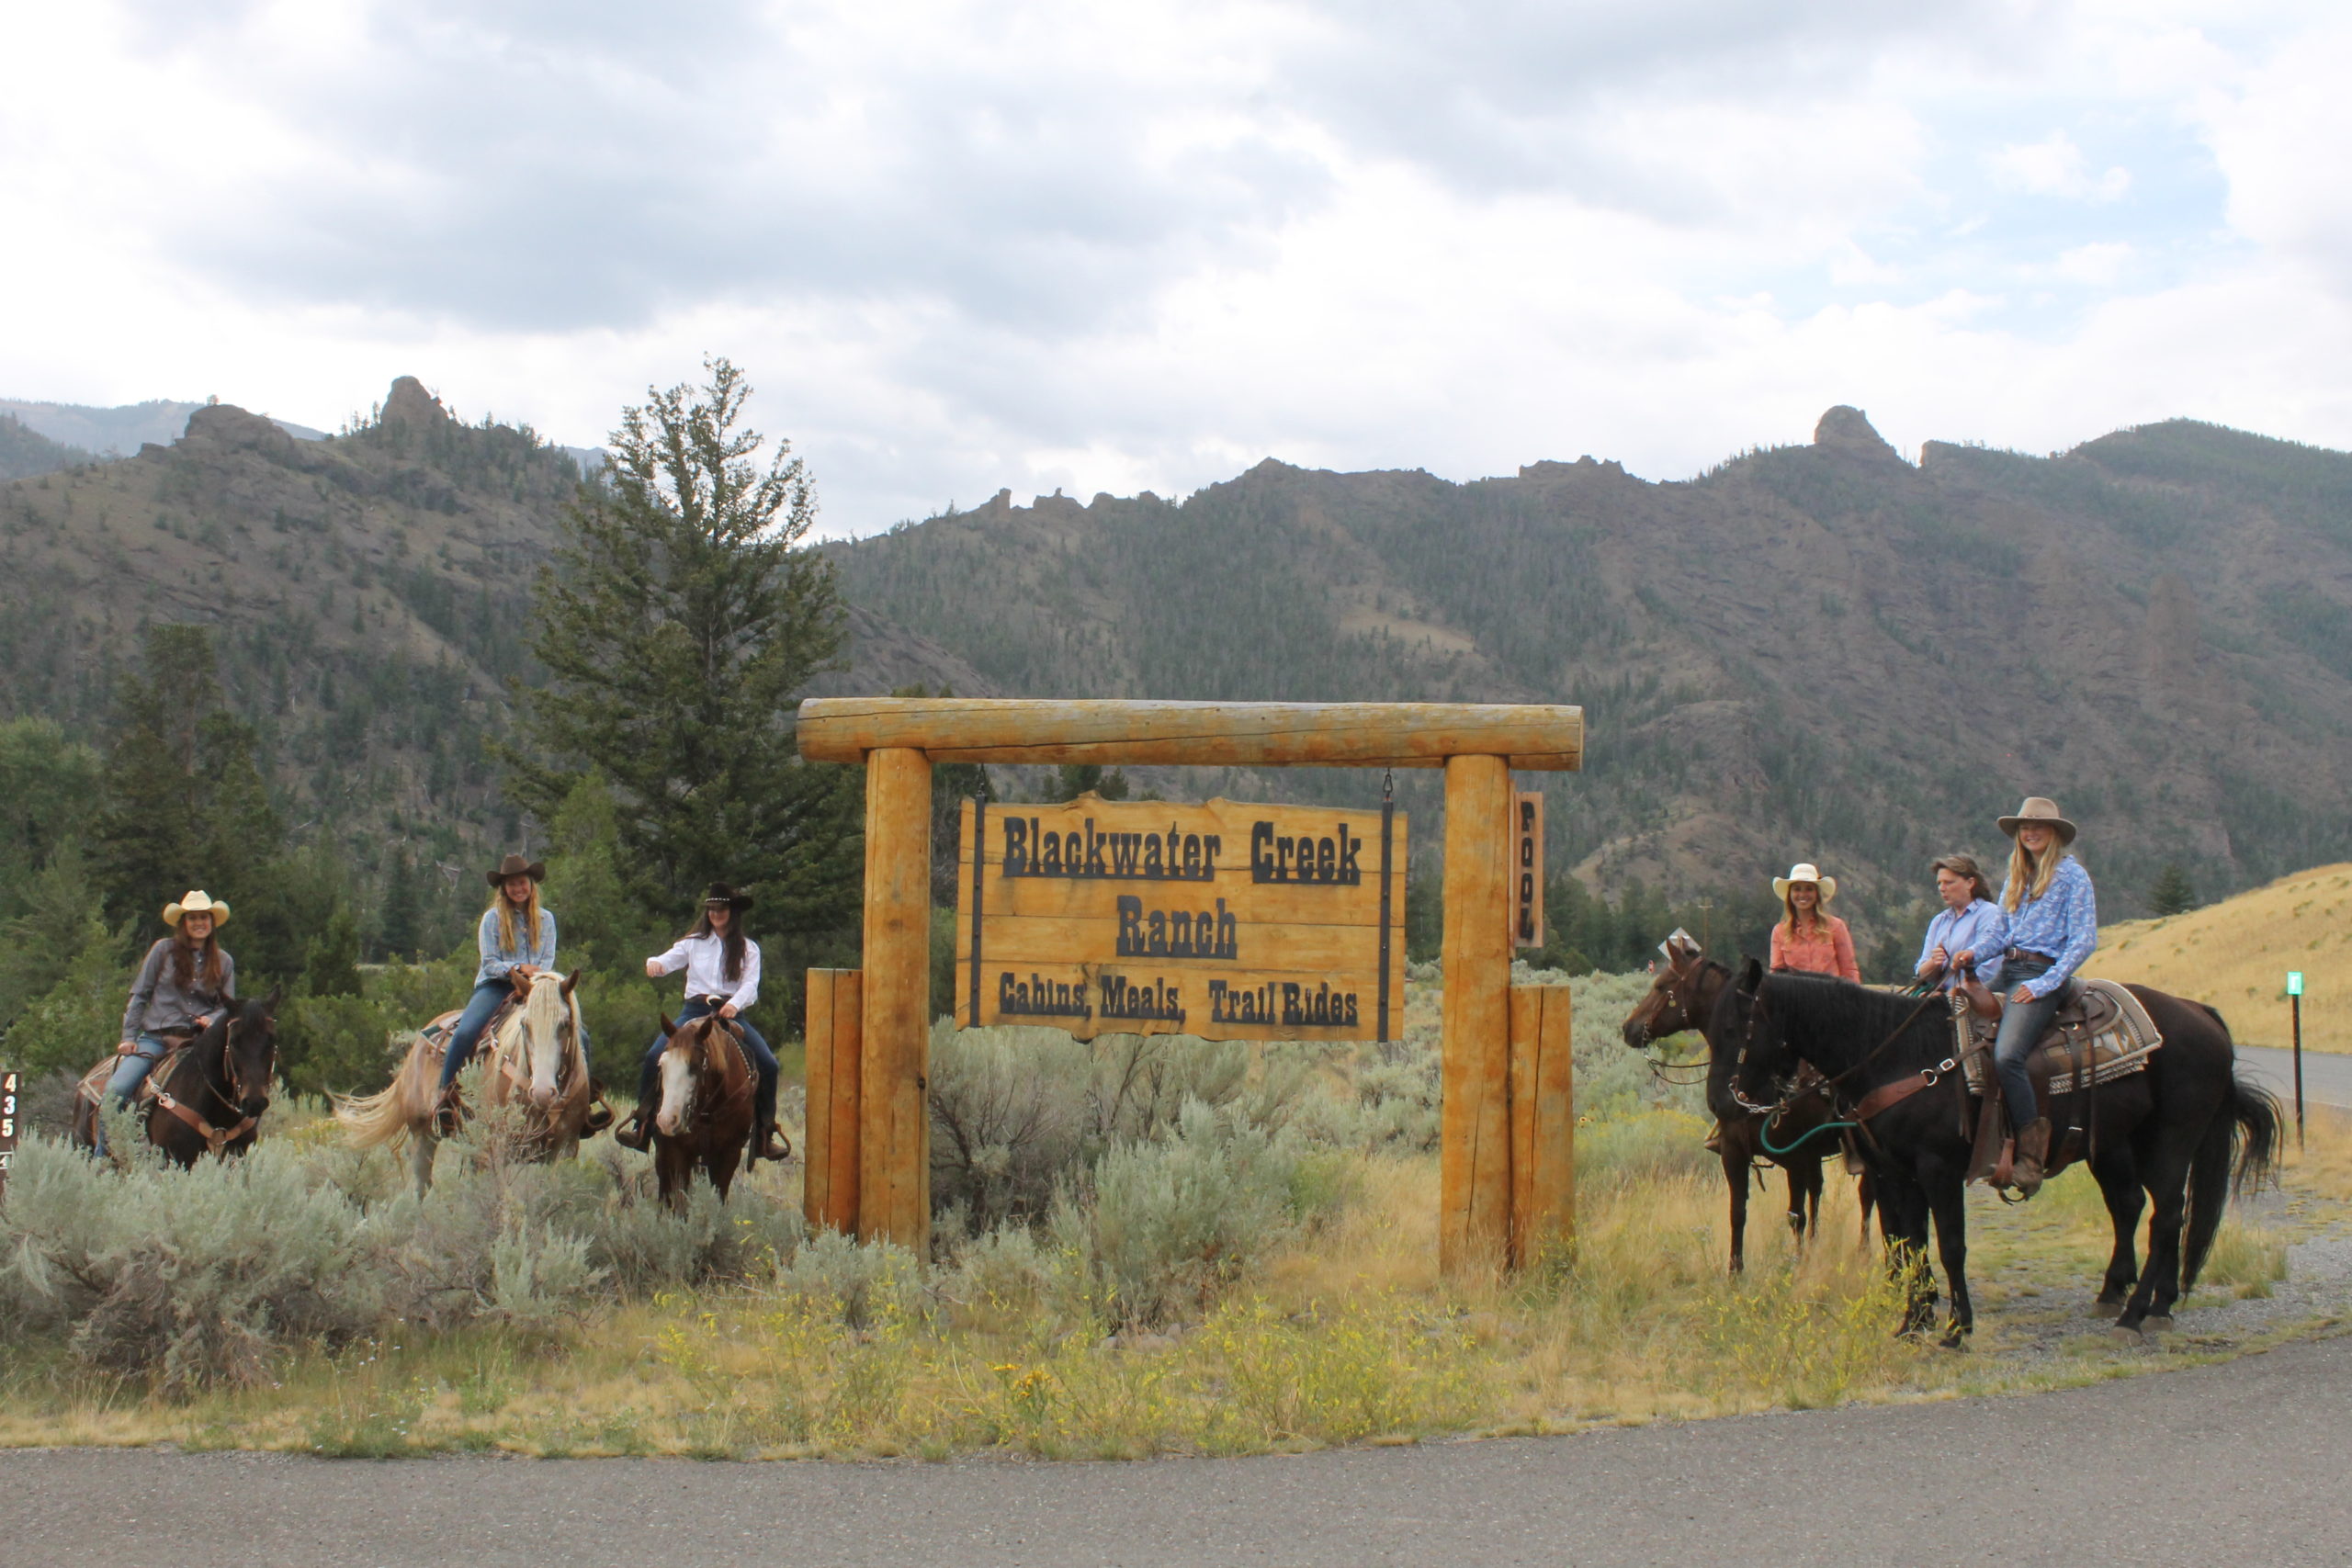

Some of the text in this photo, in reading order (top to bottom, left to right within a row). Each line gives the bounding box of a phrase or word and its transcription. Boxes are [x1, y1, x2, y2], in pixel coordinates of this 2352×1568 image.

[1003, 817, 1362, 886] Blackwater Creek
[1116, 895, 1238, 960] Ranch
[1000, 972, 1358, 1027] Cabins, Meals, Trail Rides
[2, 1073, 17, 1138] 435
